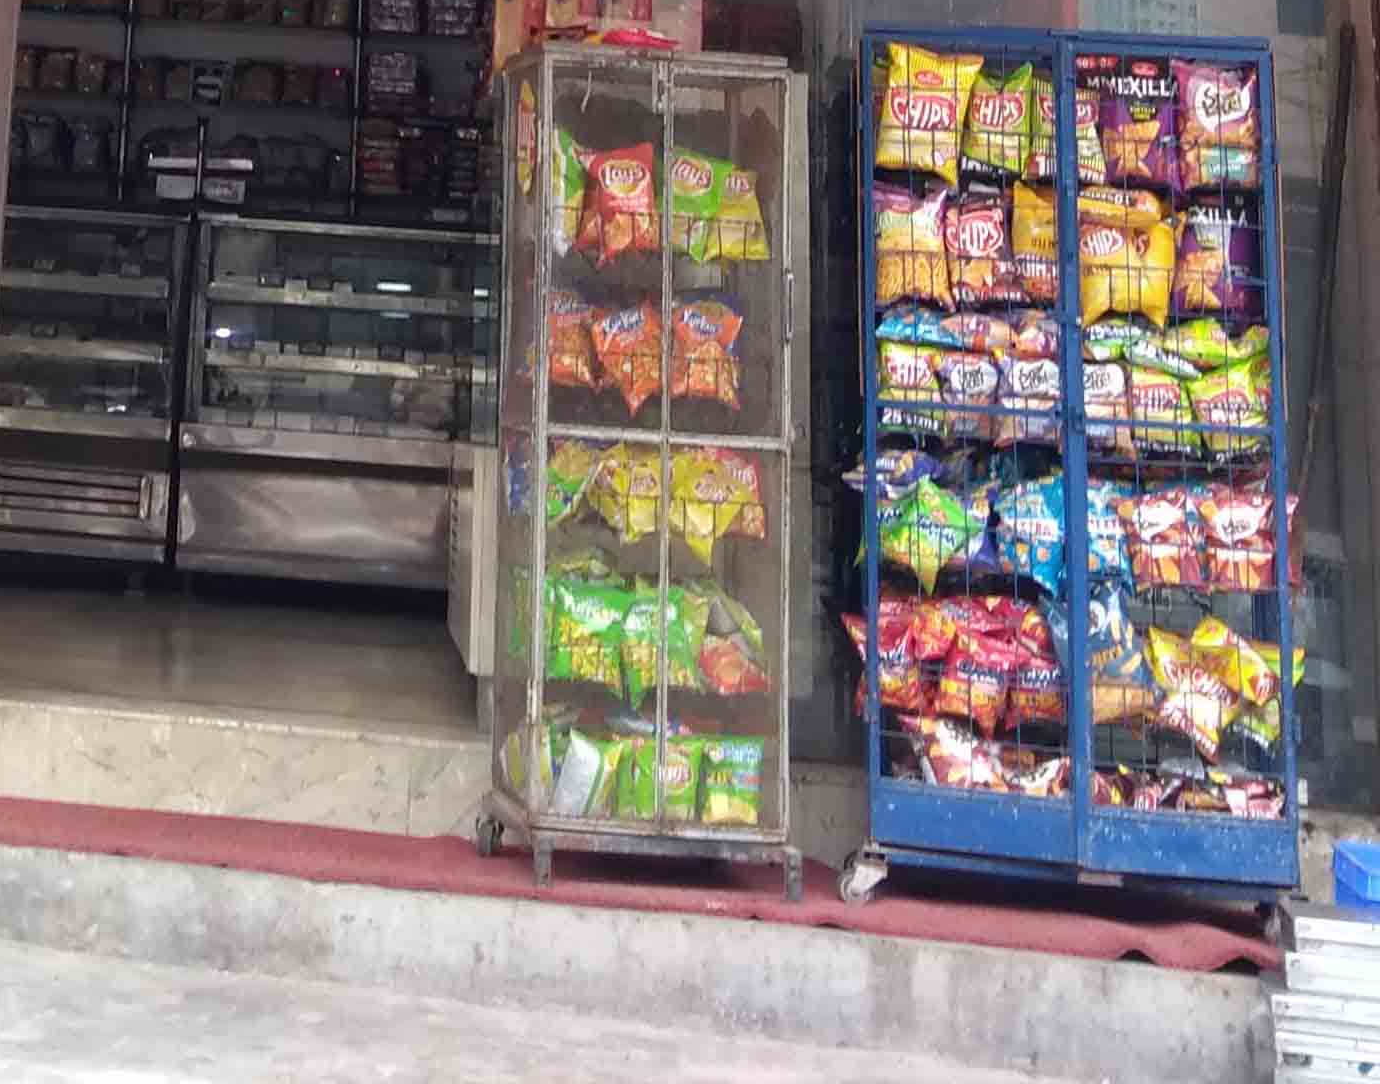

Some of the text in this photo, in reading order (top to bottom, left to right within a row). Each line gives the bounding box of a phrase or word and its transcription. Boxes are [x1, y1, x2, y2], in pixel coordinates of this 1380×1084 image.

[891, 97, 958, 130] CHIPS
[972, 96, 1025, 126] CHIPS
[946, 219, 1003, 256] CHIPS
[1080, 229, 1125, 255] CHIPS
